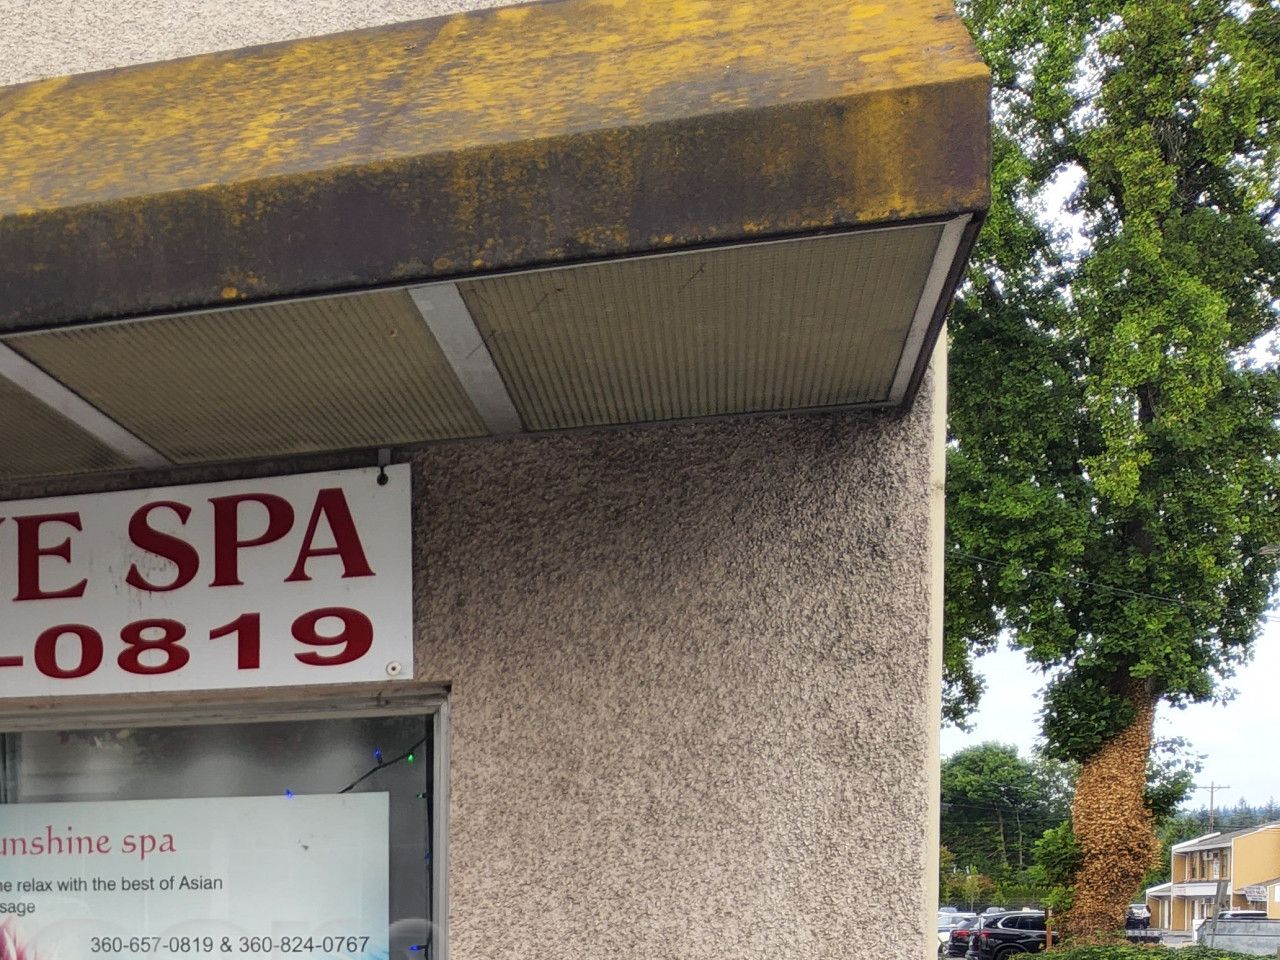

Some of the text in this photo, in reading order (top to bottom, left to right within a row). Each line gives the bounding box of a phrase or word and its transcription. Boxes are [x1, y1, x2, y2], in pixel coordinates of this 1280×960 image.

[125, 487, 376, 593] SPA
[122, 833, 178, 860] spa
[17, 876, 53, 892] relax
[57, 876, 88, 892] with
[92, 876, 117, 892] the
[121, 875, 155, 891] best
[159, 874, 175, 891] of
[179, 874, 223, 890] Asian
[90, 935, 370, 953] 360-657-0819 & 360-824-0767
